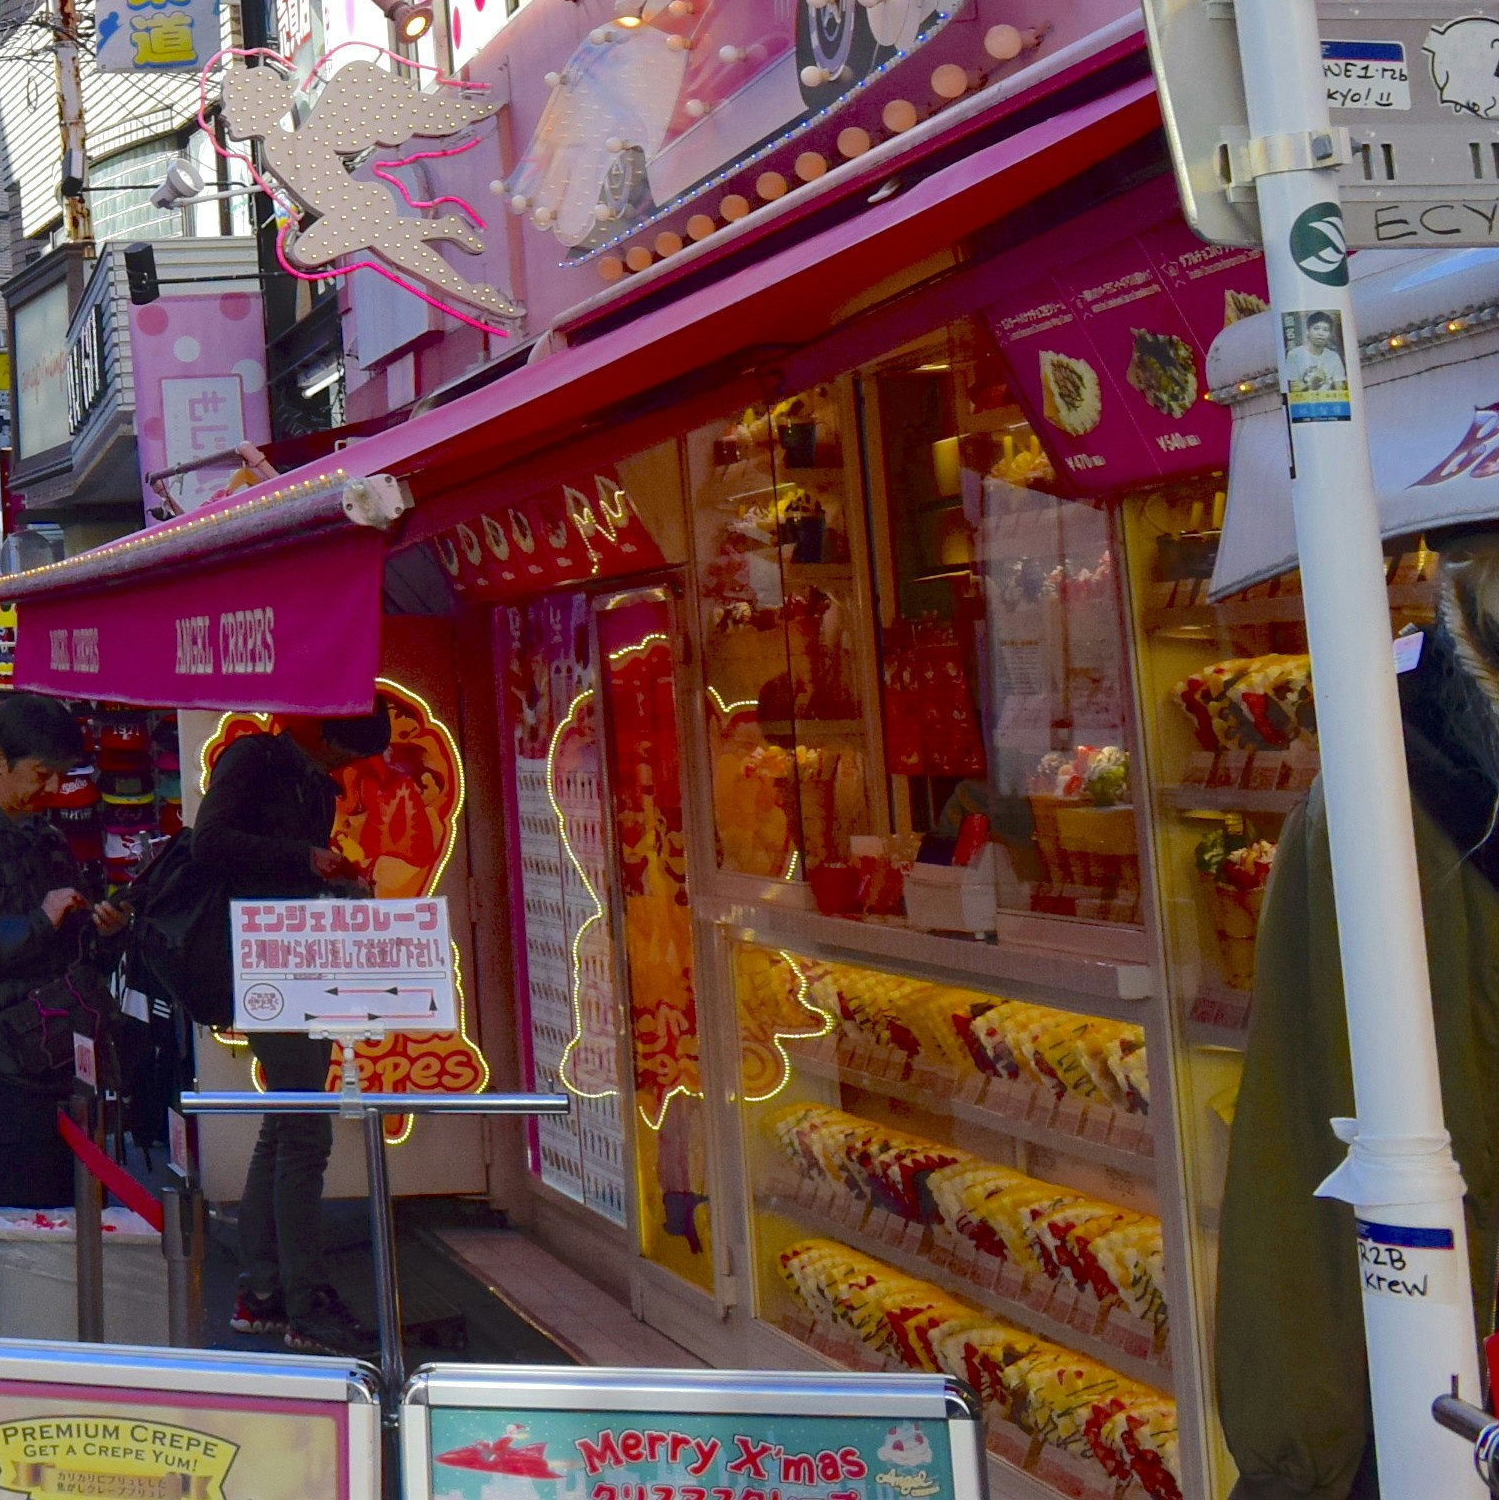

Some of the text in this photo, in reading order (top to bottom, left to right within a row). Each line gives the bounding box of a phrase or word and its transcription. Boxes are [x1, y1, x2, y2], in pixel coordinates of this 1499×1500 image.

[219, 605, 276, 675] CREPES
[241, 902, 438, 933] エンジェルクレープ
[65, 1445, 77, 1456] A
[575, 1429, 868, 1486] Merry X'mas
